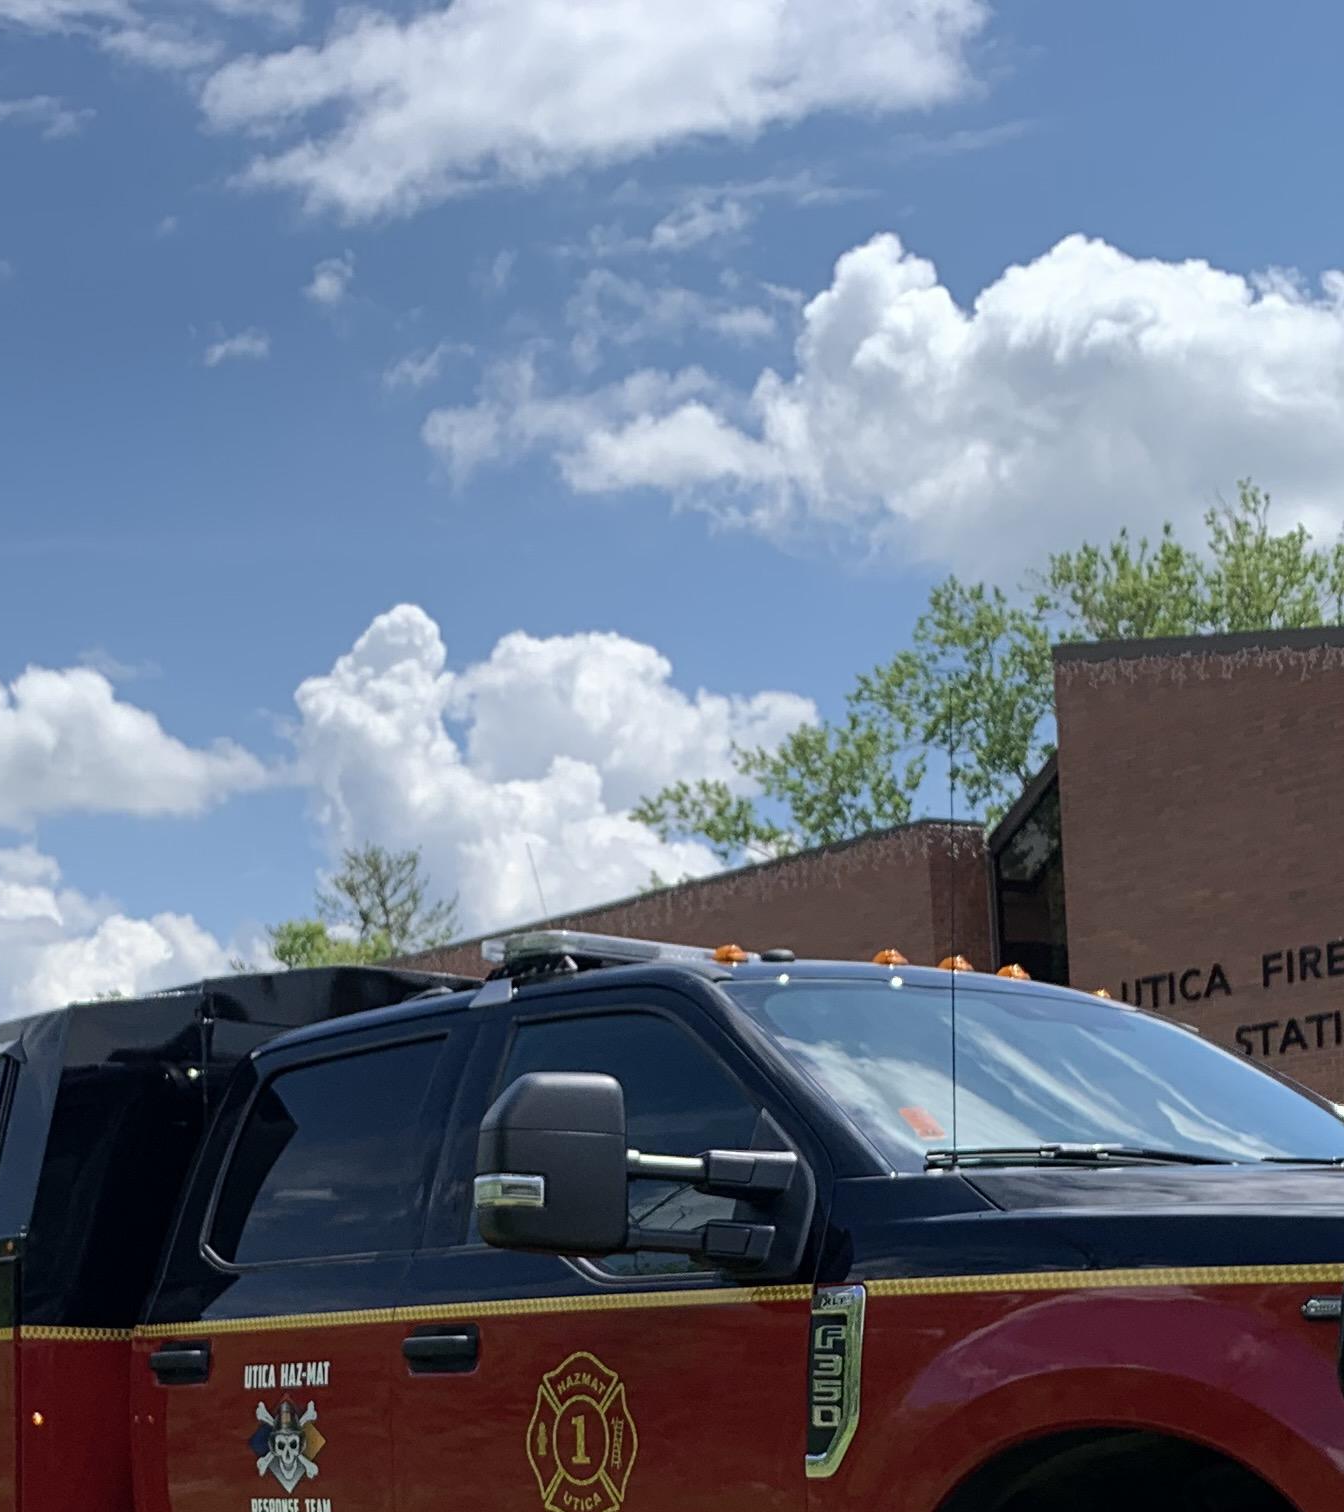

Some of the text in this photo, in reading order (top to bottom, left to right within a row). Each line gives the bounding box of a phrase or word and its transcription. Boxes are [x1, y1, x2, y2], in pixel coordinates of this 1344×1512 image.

[1121, 963, 1233, 1010] UTICA
[244, 1361, 331, 1389] UTICA HAZ-MAT
[557, 1372, 607, 1396] HAZMAT
[812, 1324, 847, 1428] F350
[571, 1414, 591, 1465] 1
[563, 1490, 603, 1512] UTICA
